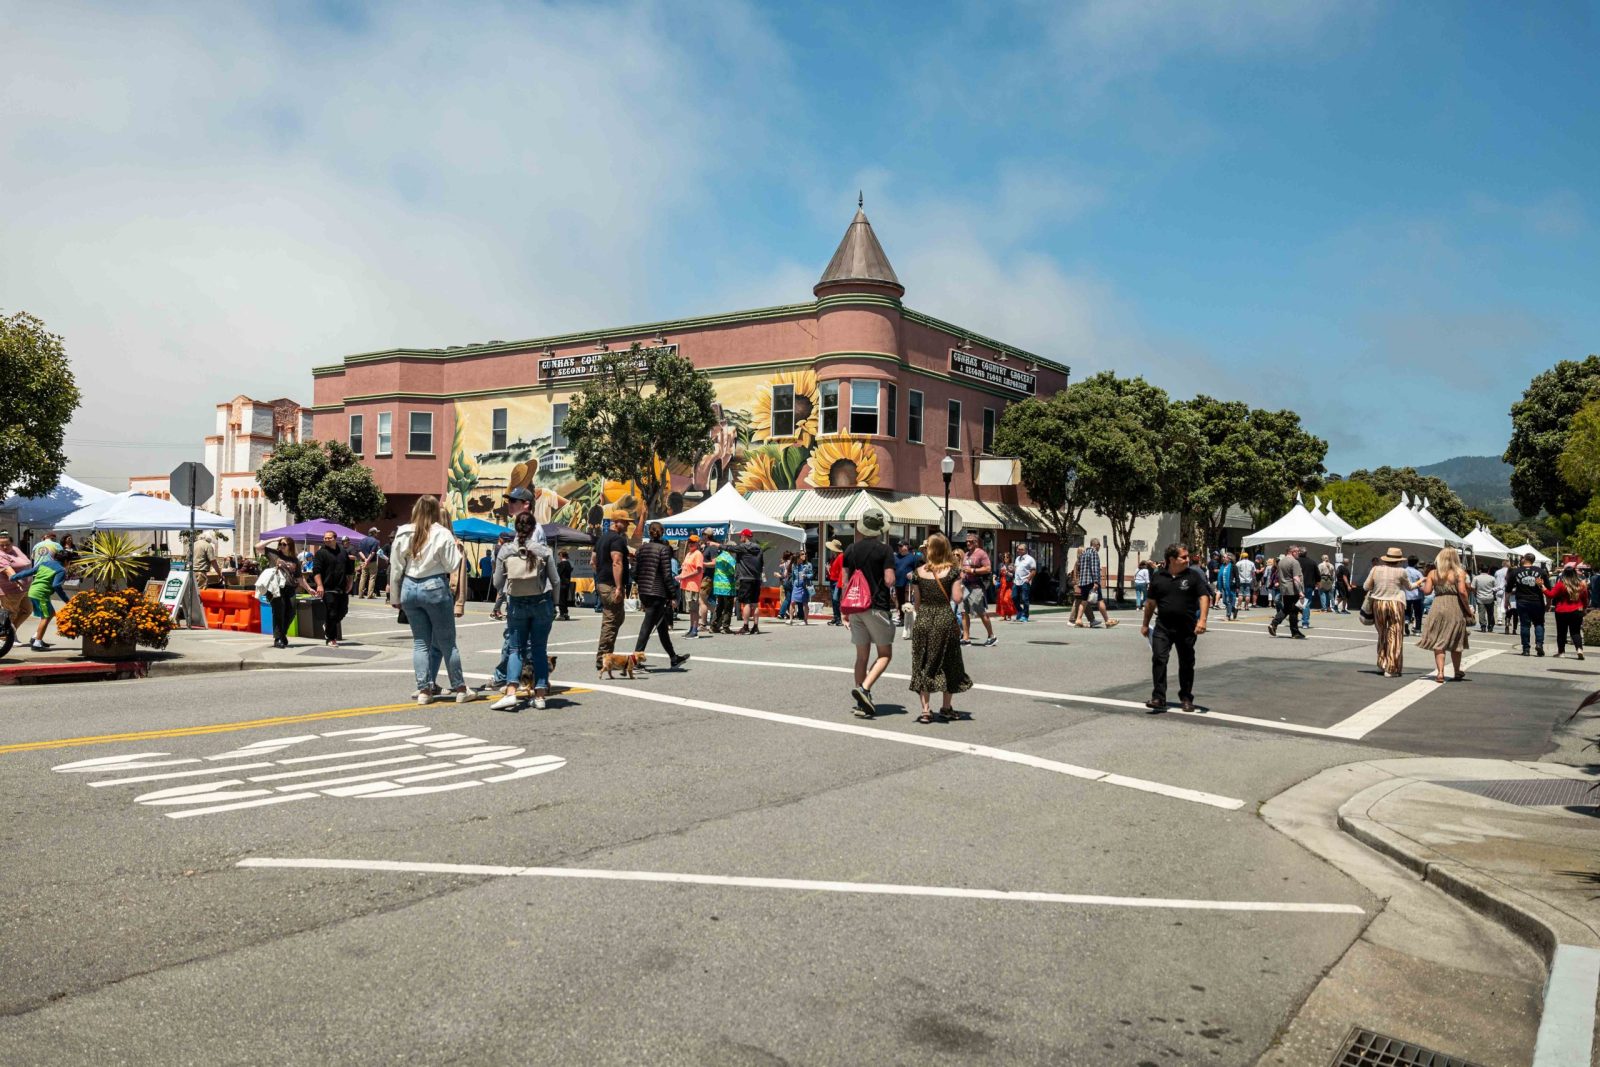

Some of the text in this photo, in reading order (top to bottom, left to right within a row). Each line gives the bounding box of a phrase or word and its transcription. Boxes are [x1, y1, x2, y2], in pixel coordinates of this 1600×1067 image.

[558, 366, 586, 376] SECOND
[665, 527, 725, 536] GLASS TENS
[51, 724, 568, 820] STOP
